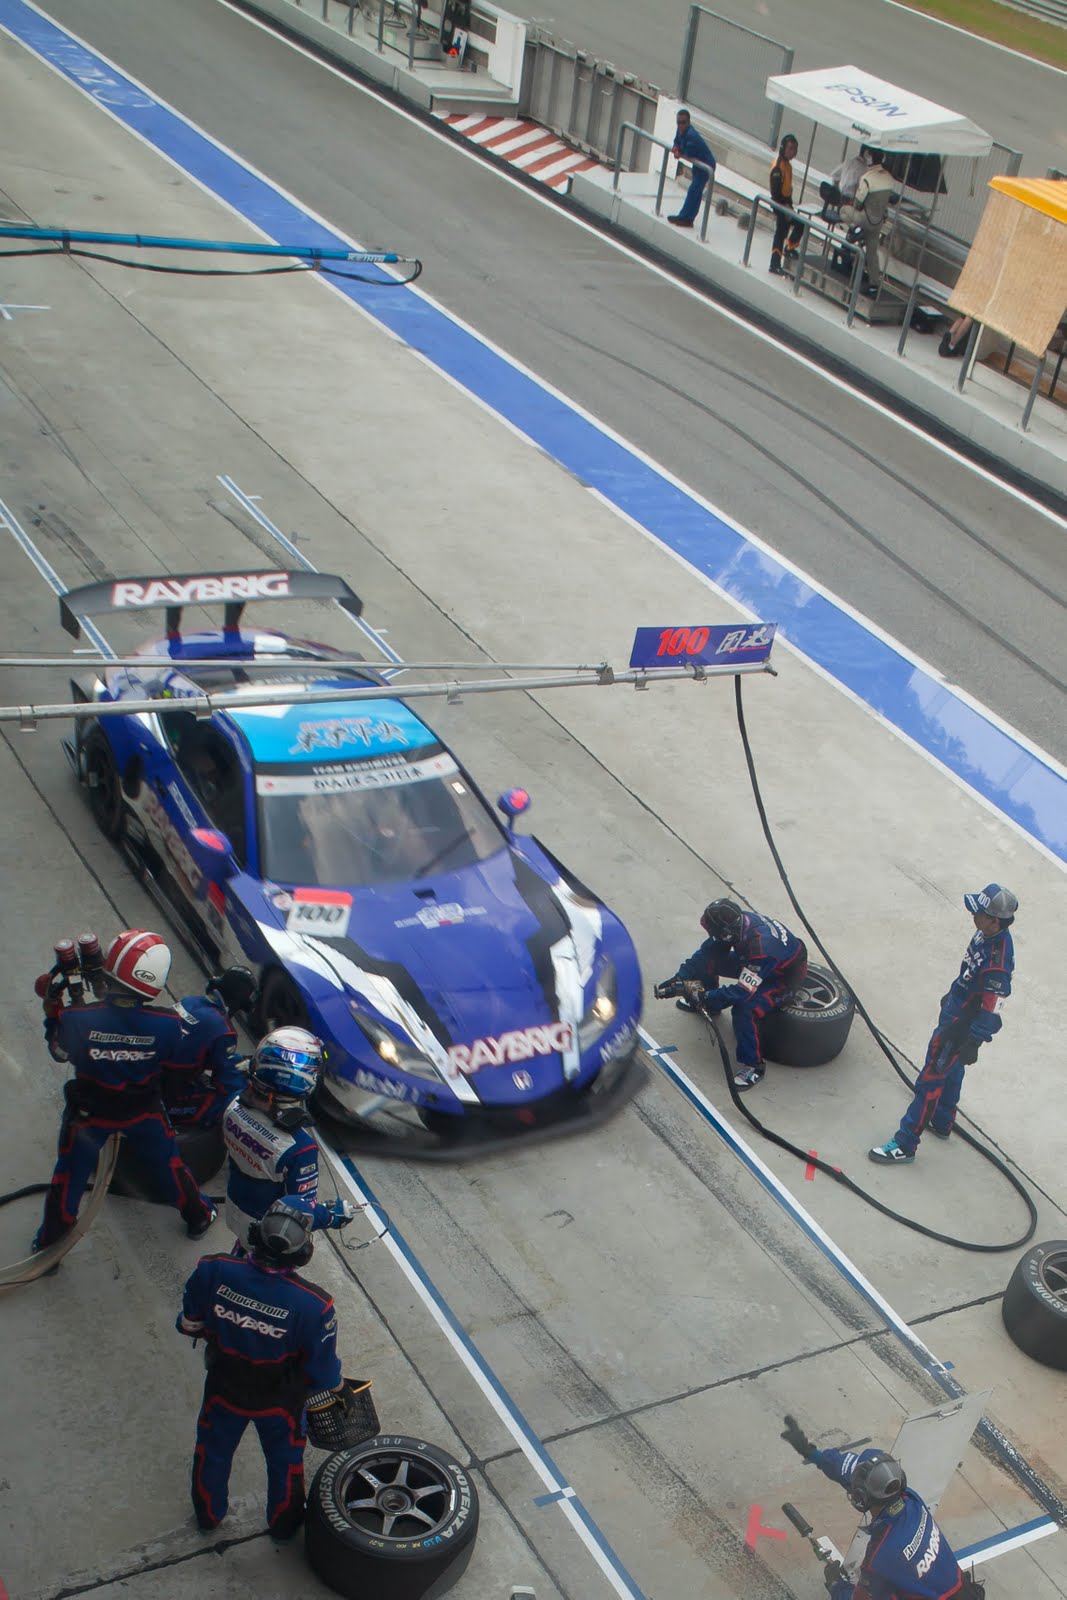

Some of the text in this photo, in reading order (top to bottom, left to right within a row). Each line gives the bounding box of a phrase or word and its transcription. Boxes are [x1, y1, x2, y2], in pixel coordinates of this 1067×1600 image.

[112, 572, 289, 606] RAYBRIG
[656, 627, 711, 656] 100
[978, 892, 991, 908] 100
[741, 972, 758, 986] 100
[90, 1048, 156, 1061] RAYBRIG
[447, 1021, 573, 1077] RAYBRIG
[226, 1117, 274, 1160] RAYBRIG
[233, 1105, 279, 1143] BRIDGESTONE
[216, 1284, 289, 1319] BRIDGESTONE
[214, 1304, 287, 1338] RAYBRIG
[319, 1450, 353, 1532] BRIDGESTONE
[440, 1464, 471, 1538] POTENZA
